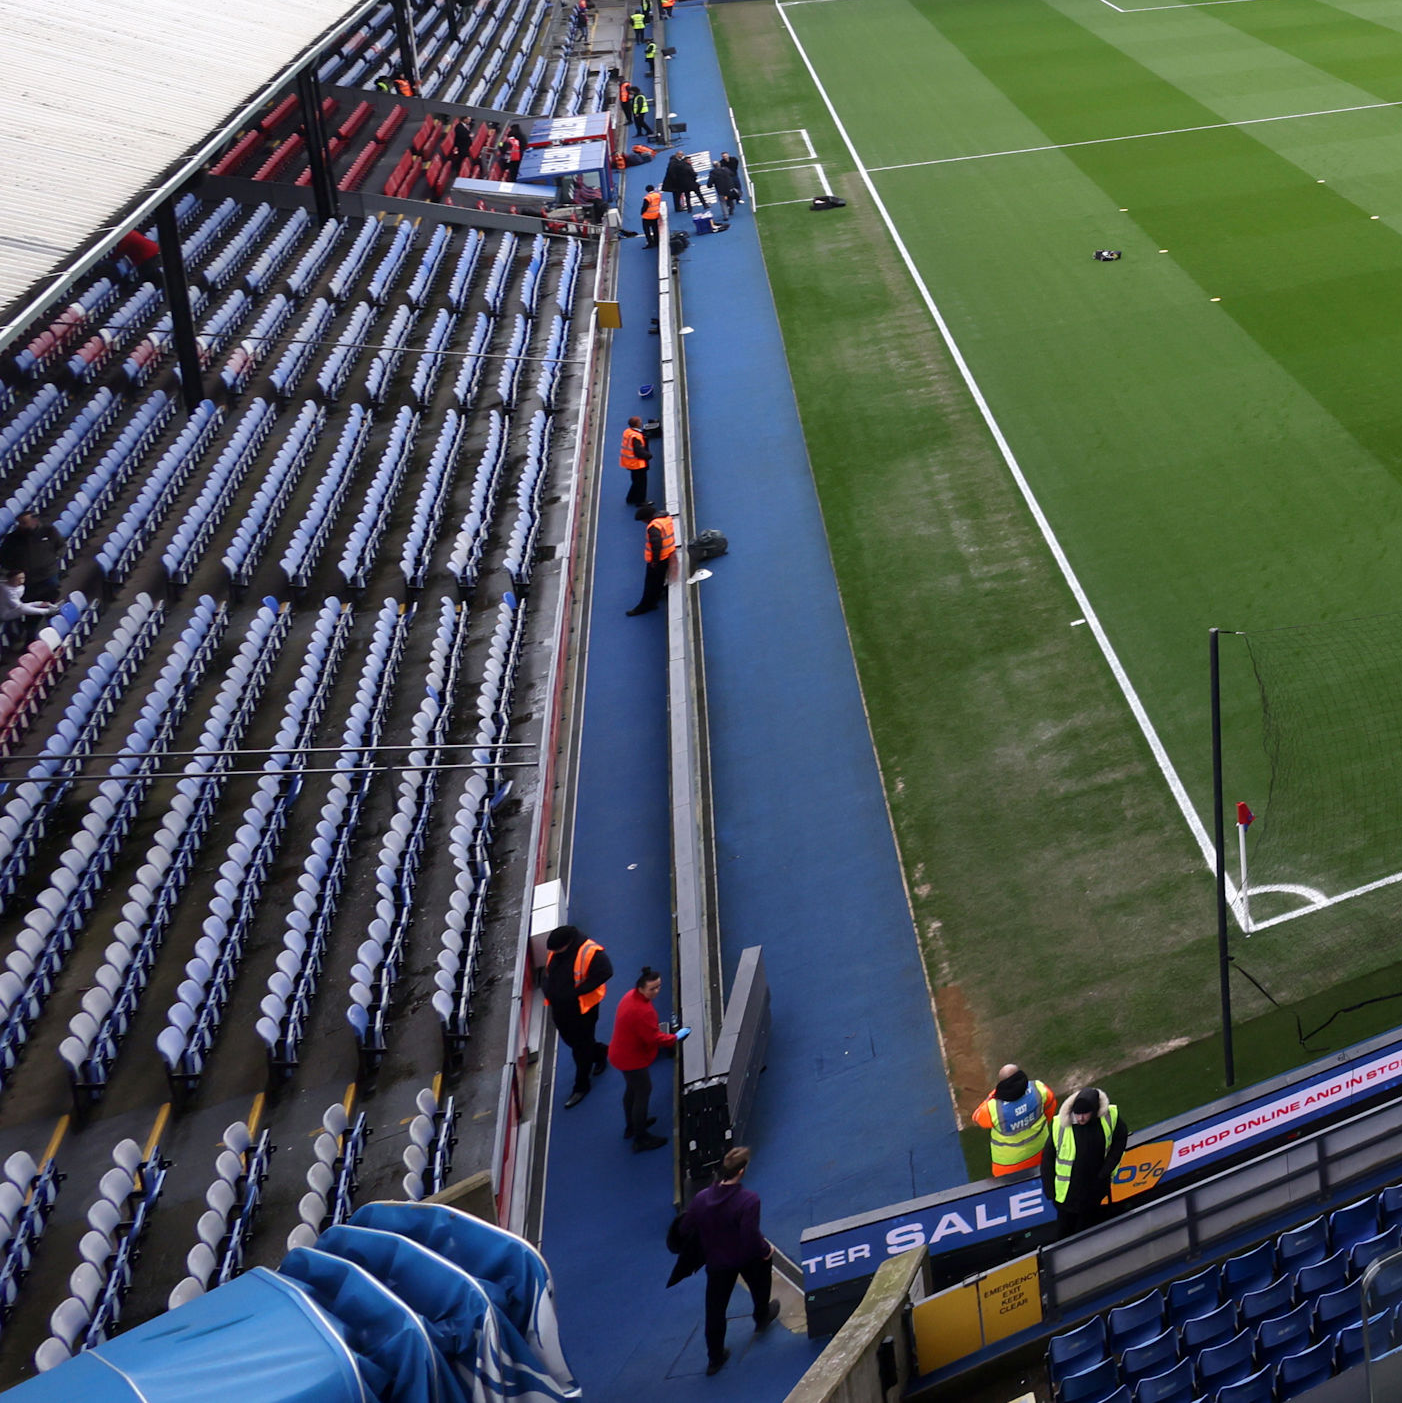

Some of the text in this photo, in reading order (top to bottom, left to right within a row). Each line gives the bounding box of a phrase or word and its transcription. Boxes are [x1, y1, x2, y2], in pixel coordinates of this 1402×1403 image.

[1010, 1112, 1035, 1131] WISE
[1178, 1129, 1231, 1158] SHOP
[1233, 1101, 1301, 1136] ONLINE
[1303, 1084, 1342, 1107] AND
[1345, 1075, 1363, 1089] IN
[1114, 1160, 1165, 1186] 0%
[886, 1188, 1045, 1255] SALE
[984, 1271, 1039, 1299] EMERGENCY
[1002, 1285, 1022, 1298] EXIT
[999, 1298, 1029, 1315] CLEAR
[1001, 1292, 1025, 1306] KEEP
